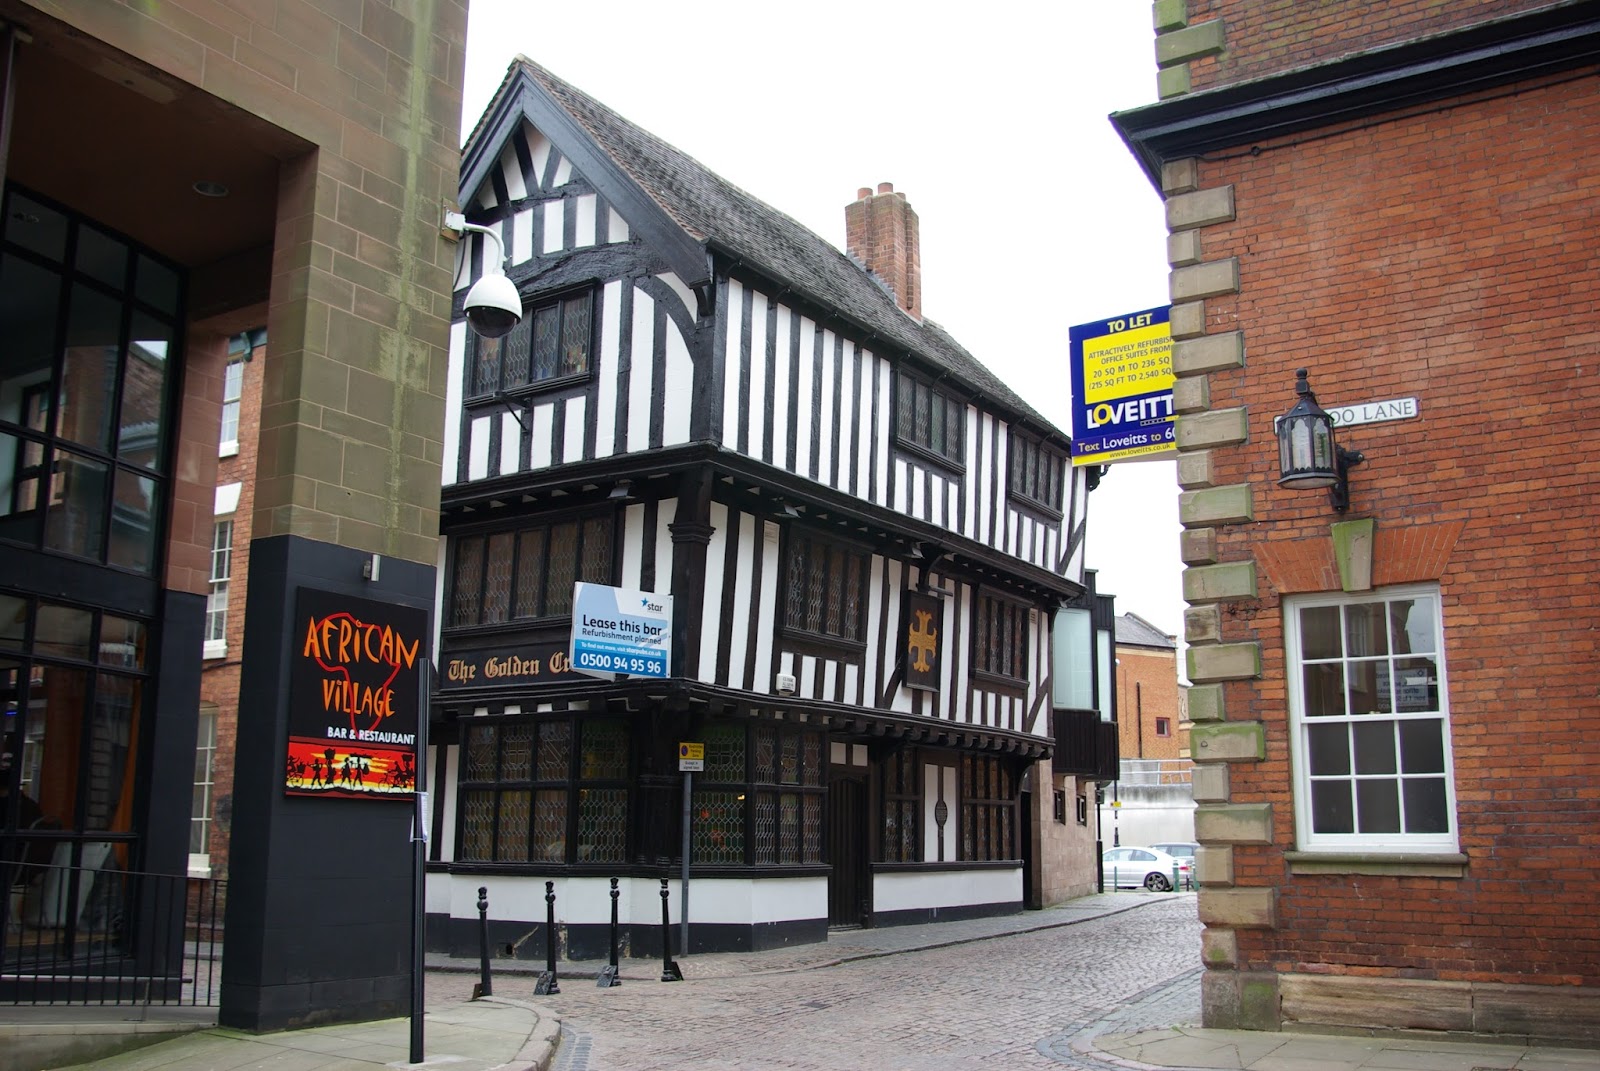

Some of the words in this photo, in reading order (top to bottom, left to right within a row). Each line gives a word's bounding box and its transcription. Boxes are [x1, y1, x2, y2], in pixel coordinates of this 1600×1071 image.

[1107, 319, 1125, 333] TO
[1129, 313, 1153, 329] LET
[1088, 343, 1135, 360] ATTRACTIVELY
[1101, 353, 1124, 365] OFFICE
[1126, 348, 1148, 360] SUITES
[1150, 344, 1171, 355] FROM
[1093, 369, 1102, 379] 20
[1105, 367, 1115, 377] SQ
[1118, 365, 1125, 373] M
[1128, 362, 1139, 371] TO
[1141, 359, 1156, 369] 236
[1158, 356, 1170, 365] SQ
[1088, 380, 1103, 390] (215
[1104, 378, 1115, 387] SQ
[1116, 376, 1125, 384] FT
[1128, 374, 1137, 382] TO
[1161, 367, 1172, 375] SQ
[1086, 393, 1174, 430] LOVEITT
[1363, 401, 1413, 420] LANE
[1078, 442, 1100, 453] Text
[1102, 433, 1148, 449] Loveitts
[1150, 433, 1162, 442] to
[1109, 443, 1171, 458] www.loveitts.co.uk
[647, 602, 664, 612] star
[583, 614, 617, 630] Lease
[619, 619, 641, 634] this
[643, 622, 662, 636] bar
[582, 627, 633, 641] Refurbishment
[634, 636, 662, 645] planned
[448, 660, 477, 684] The
[484, 656, 540, 678] Golden
[580, 652, 611, 668] 0500
[613, 656, 628, 670] 94
[630, 658, 645, 672] 95
[647, 660, 661, 674] 96
[327, 726, 348, 740] BAR
[349, 728, 356, 740] &
[358, 729, 415, 745] RESTAURANT
